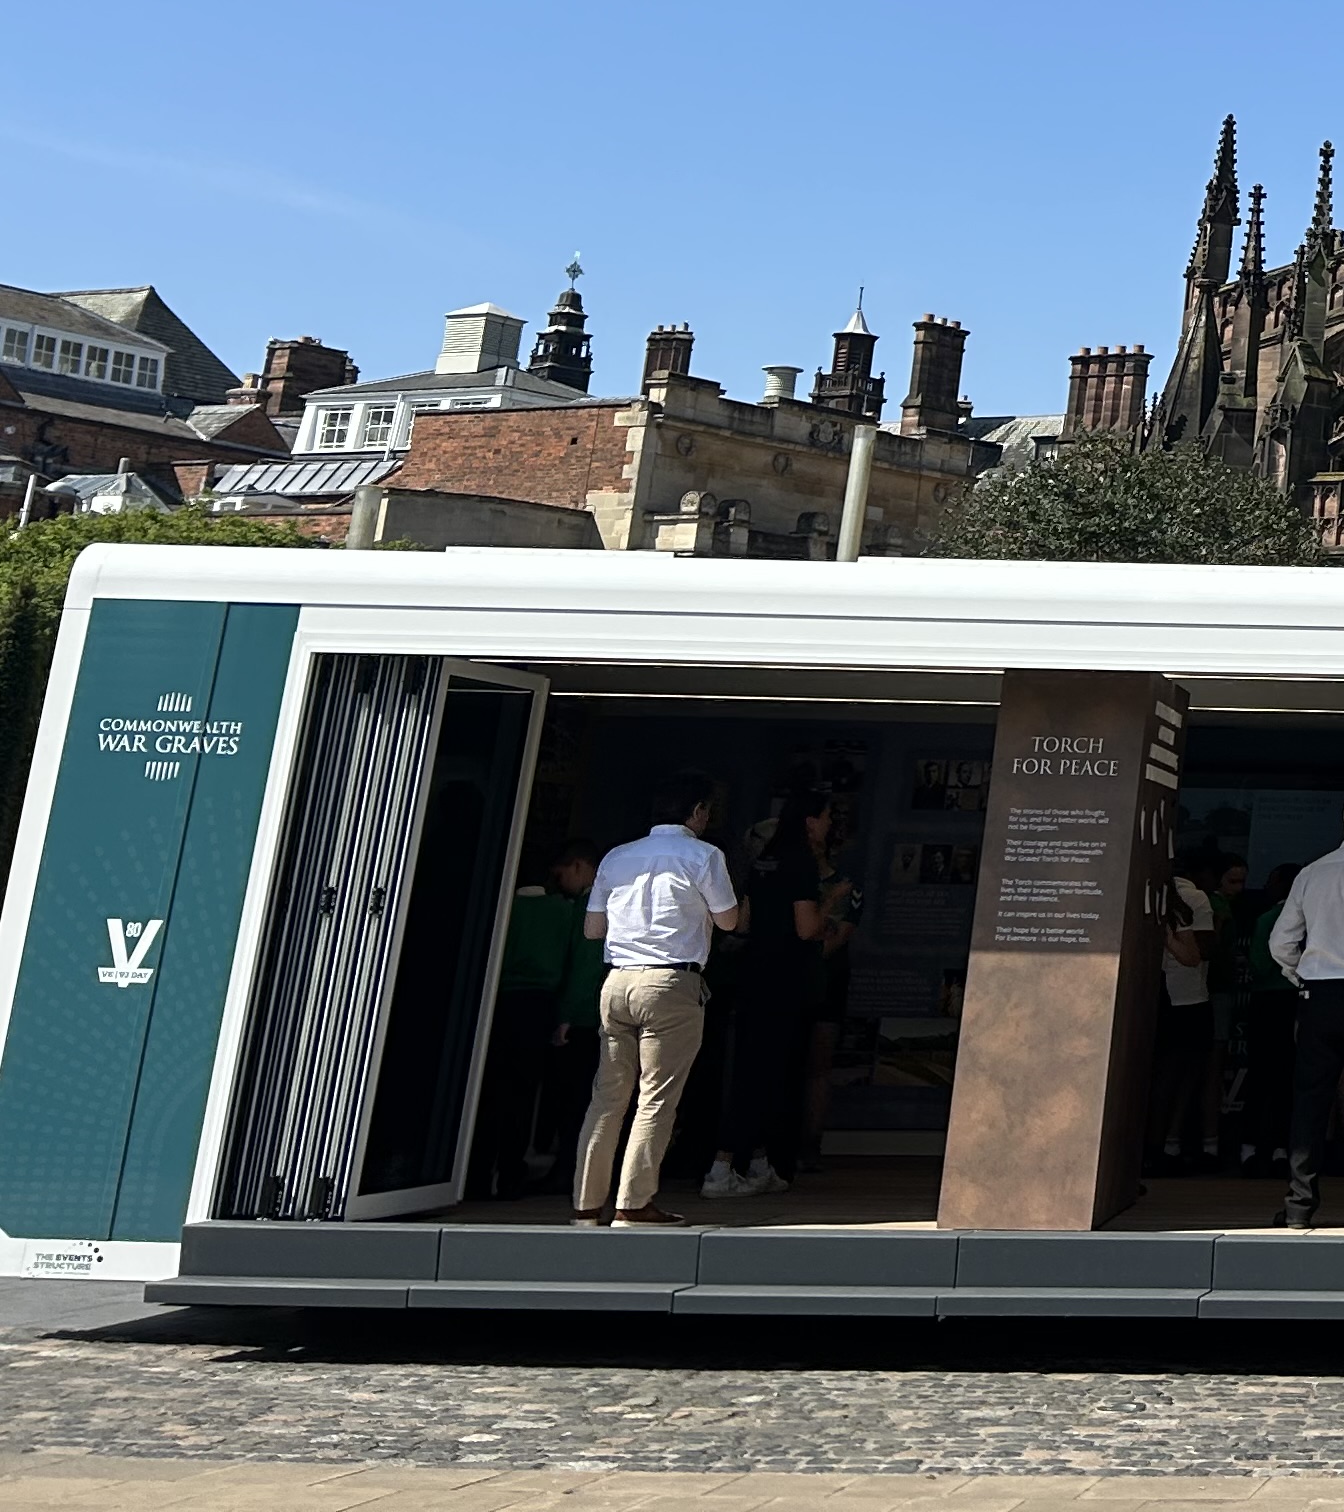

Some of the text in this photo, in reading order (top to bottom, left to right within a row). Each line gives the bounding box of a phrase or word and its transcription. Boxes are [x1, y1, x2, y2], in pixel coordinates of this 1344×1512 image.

[100, 719, 242, 734] COMMONWEALTH
[98, 734, 240, 755] WAR GRAVES
[1032, 737, 1104, 754] TORCH
[1012, 758, 1119, 776] FOR PEACE
[126, 922, 142, 937] 80
[35, 1253, 93, 1262] THE EVENTS
[33, 1262, 91, 1270] STRUCTURE
